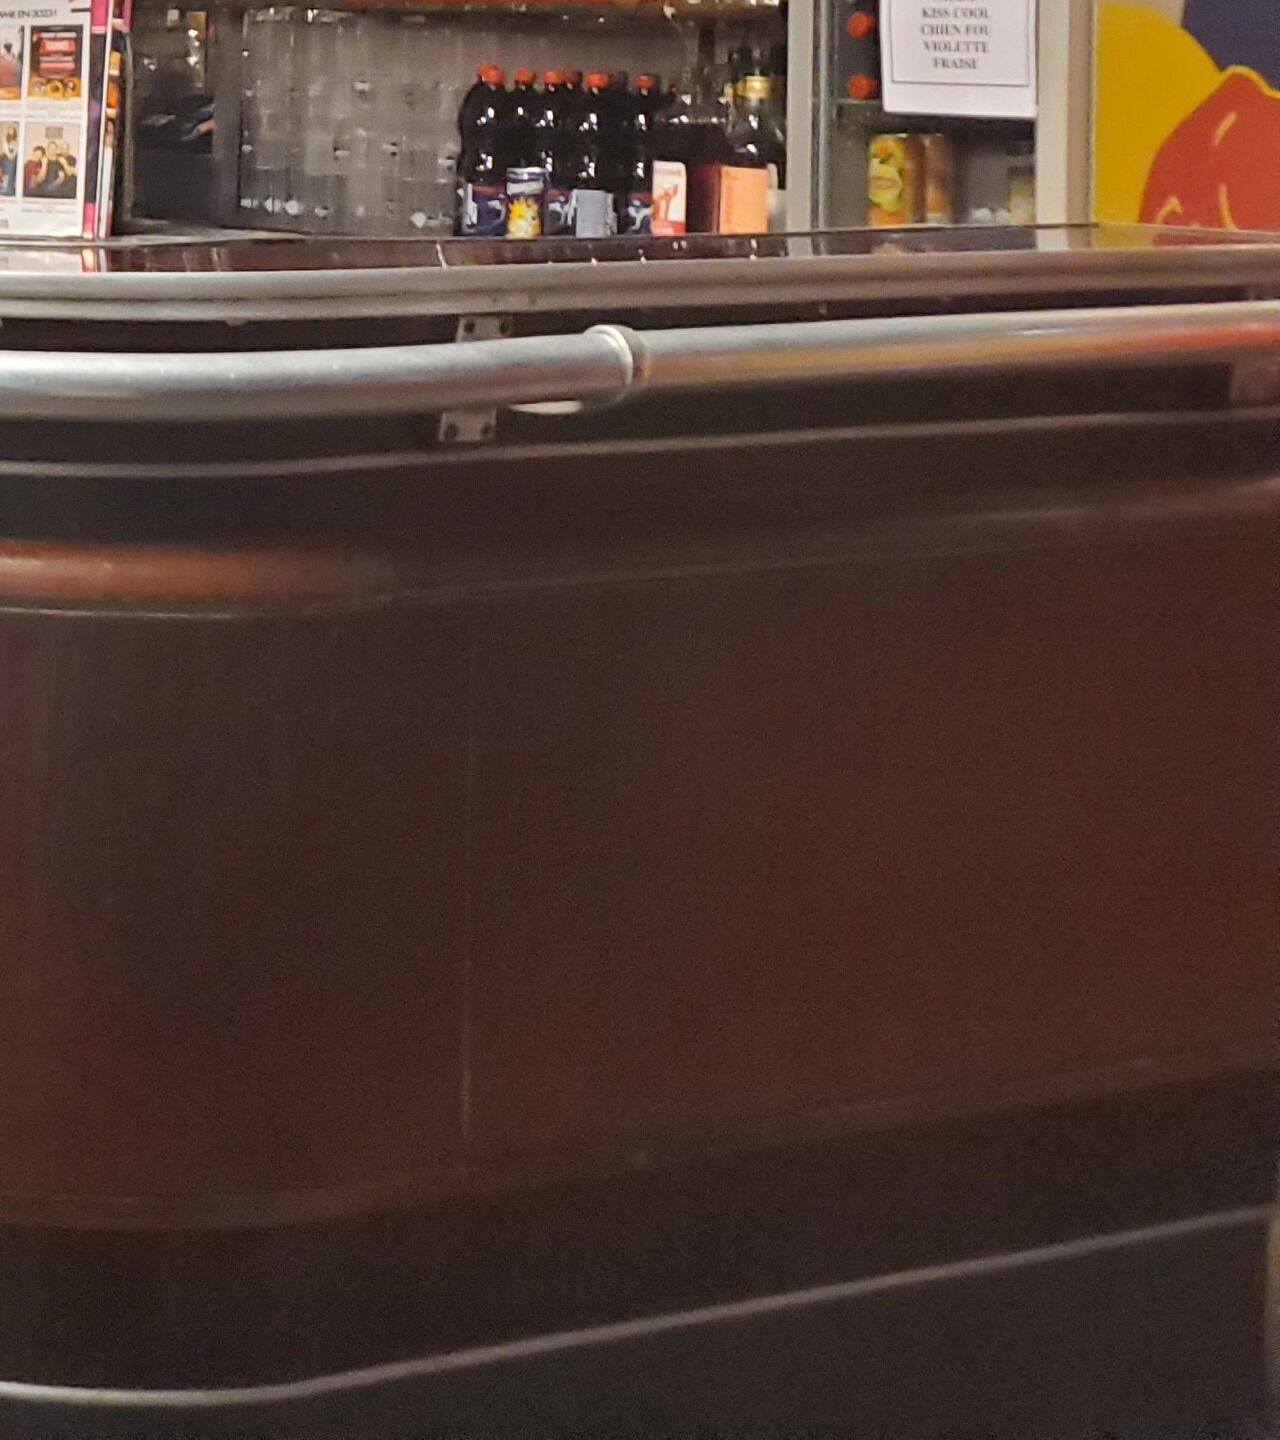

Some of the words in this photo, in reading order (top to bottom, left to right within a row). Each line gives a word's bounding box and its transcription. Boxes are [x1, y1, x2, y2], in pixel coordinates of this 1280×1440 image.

[921, 7, 951, 19] KISS
[920, 23, 961, 36] CHIEN
[923, 40, 990, 54] VIOLETTE
[932, 58, 979, 70] FRAISE
